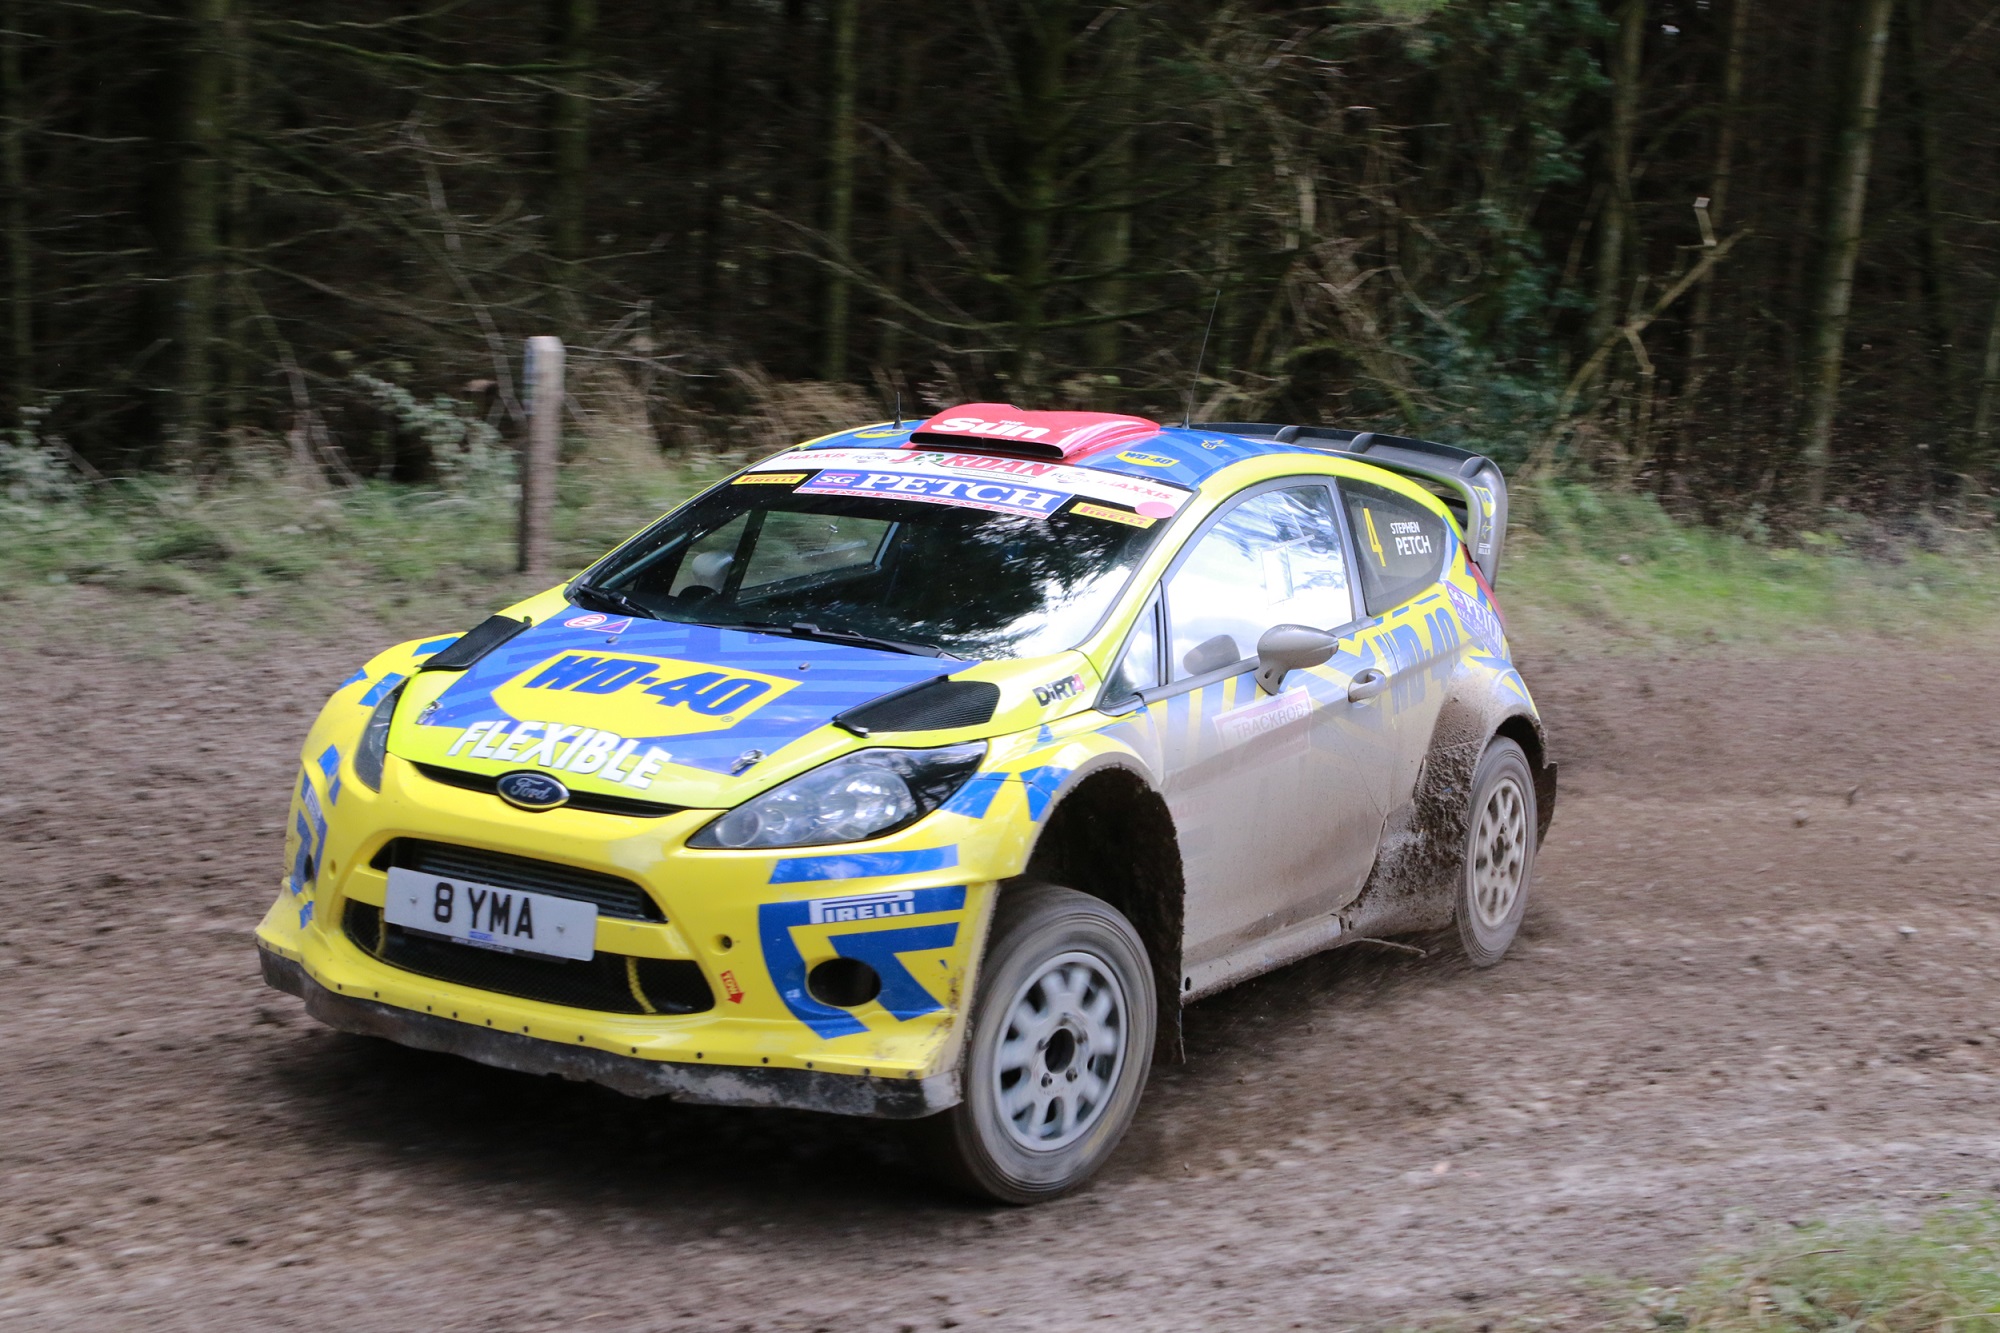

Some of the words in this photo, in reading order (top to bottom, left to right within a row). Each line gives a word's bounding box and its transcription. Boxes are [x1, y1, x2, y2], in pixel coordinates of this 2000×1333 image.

[931, 417, 1050, 439] Sun
[1123, 451, 1174, 465] WD-40
[744, 475, 799, 483] PIRELLI
[815, 474, 856, 485] SG
[852, 473, 1061, 511] PETCH
[1079, 505, 1148, 526] PIRELLI
[1390, 521, 1421, 535] STEPHEN
[1362, 507, 1387, 567] 4
[1395, 535, 1432, 556] PETCH
[524, 654, 772, 717] WD-40
[1233, 702, 1305, 740] TRACKROD
[446, 719, 673, 790] FLEXIBLE
[510, 776, 550, 801] Ford
[434, 881, 454, 924] 8
[468, 887, 534, 939] YMA
[808, 890, 915, 924] PIRELLI
